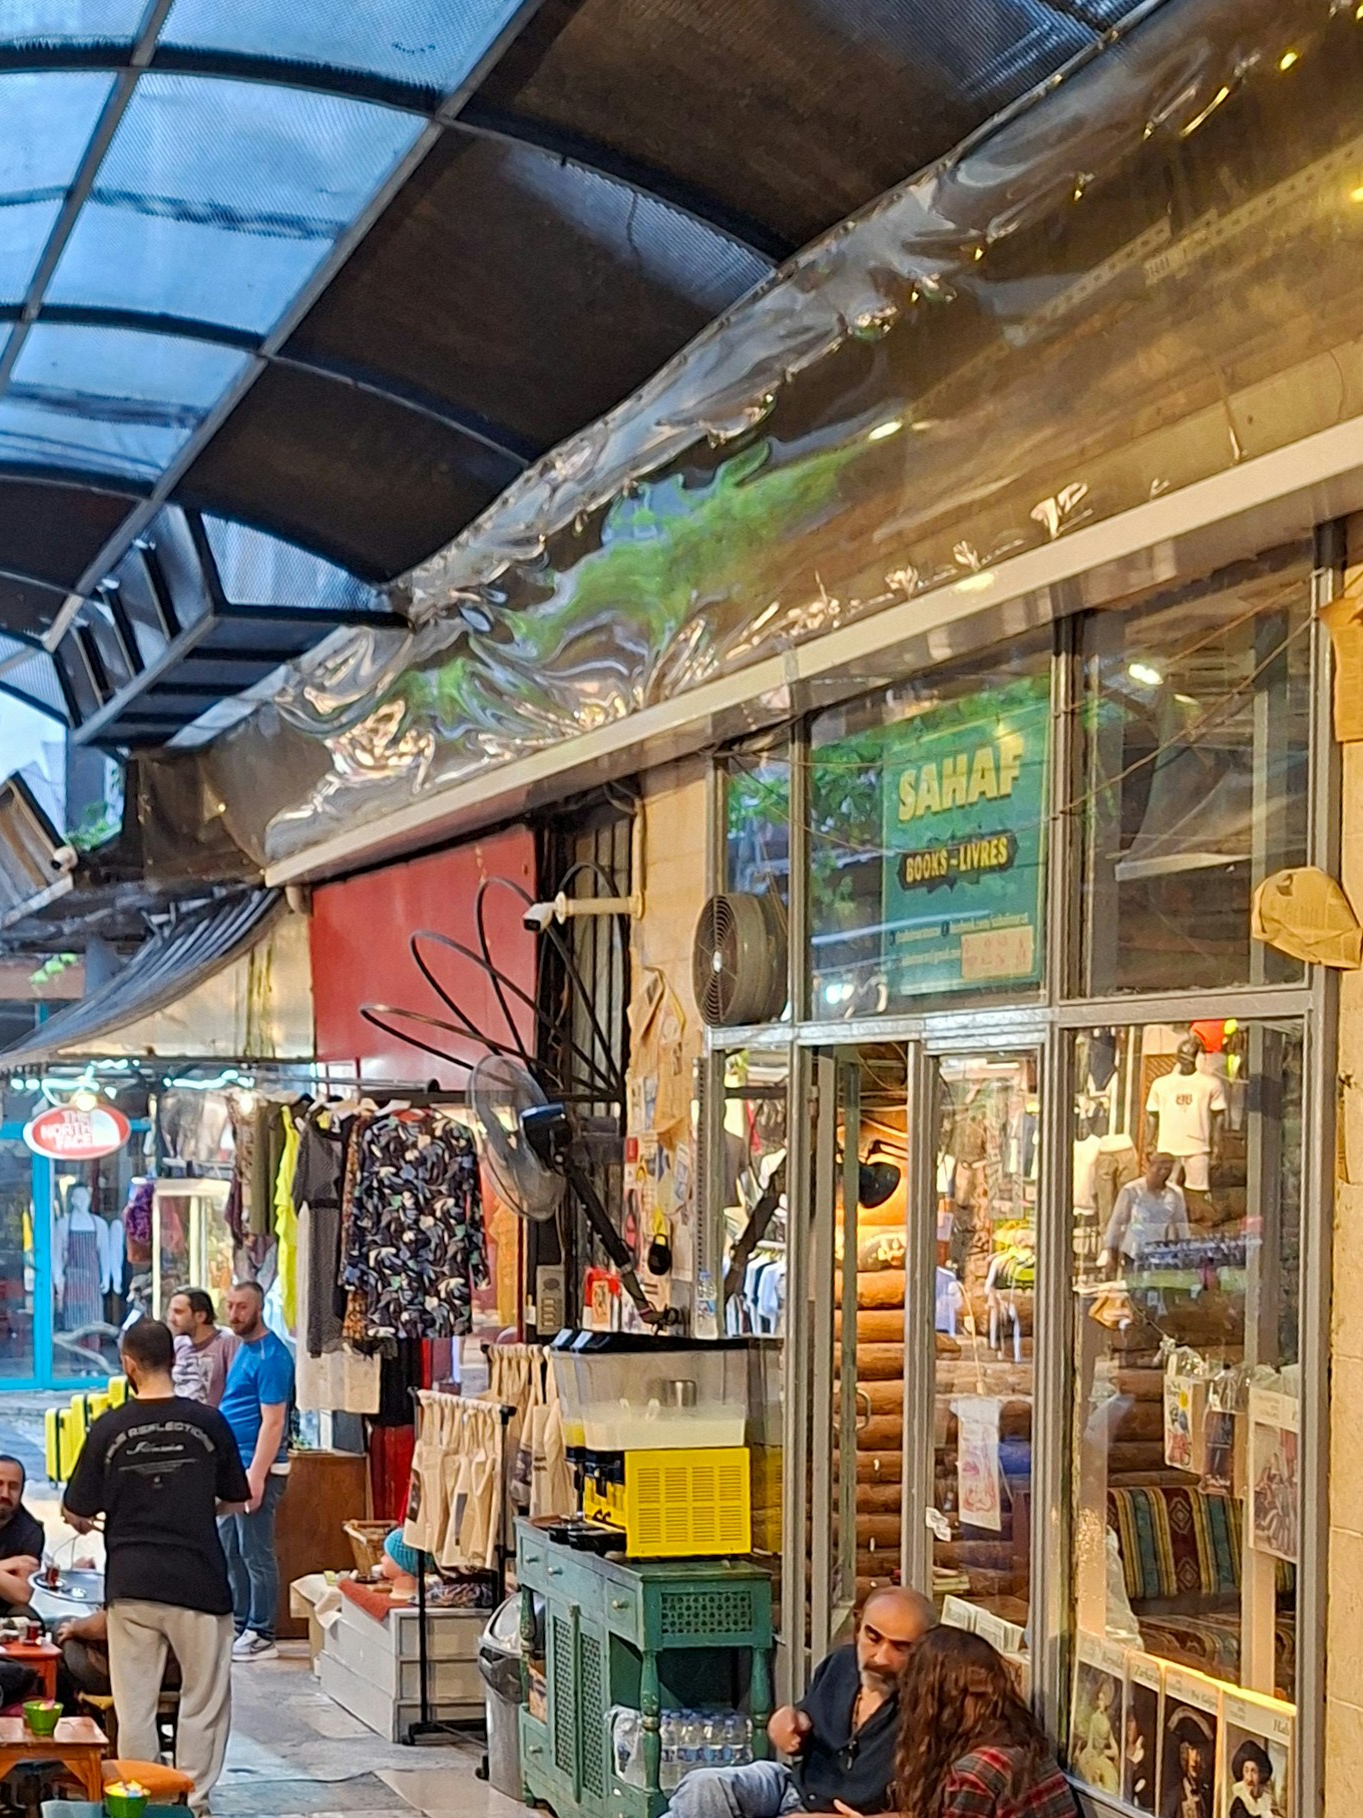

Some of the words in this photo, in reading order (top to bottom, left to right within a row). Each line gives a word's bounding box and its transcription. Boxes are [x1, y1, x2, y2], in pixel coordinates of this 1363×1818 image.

[898, 735, 1024, 823] SAHAF
[905, 850, 949, 884] BOOKS
[958, 836, 1009, 872] LIVRES
